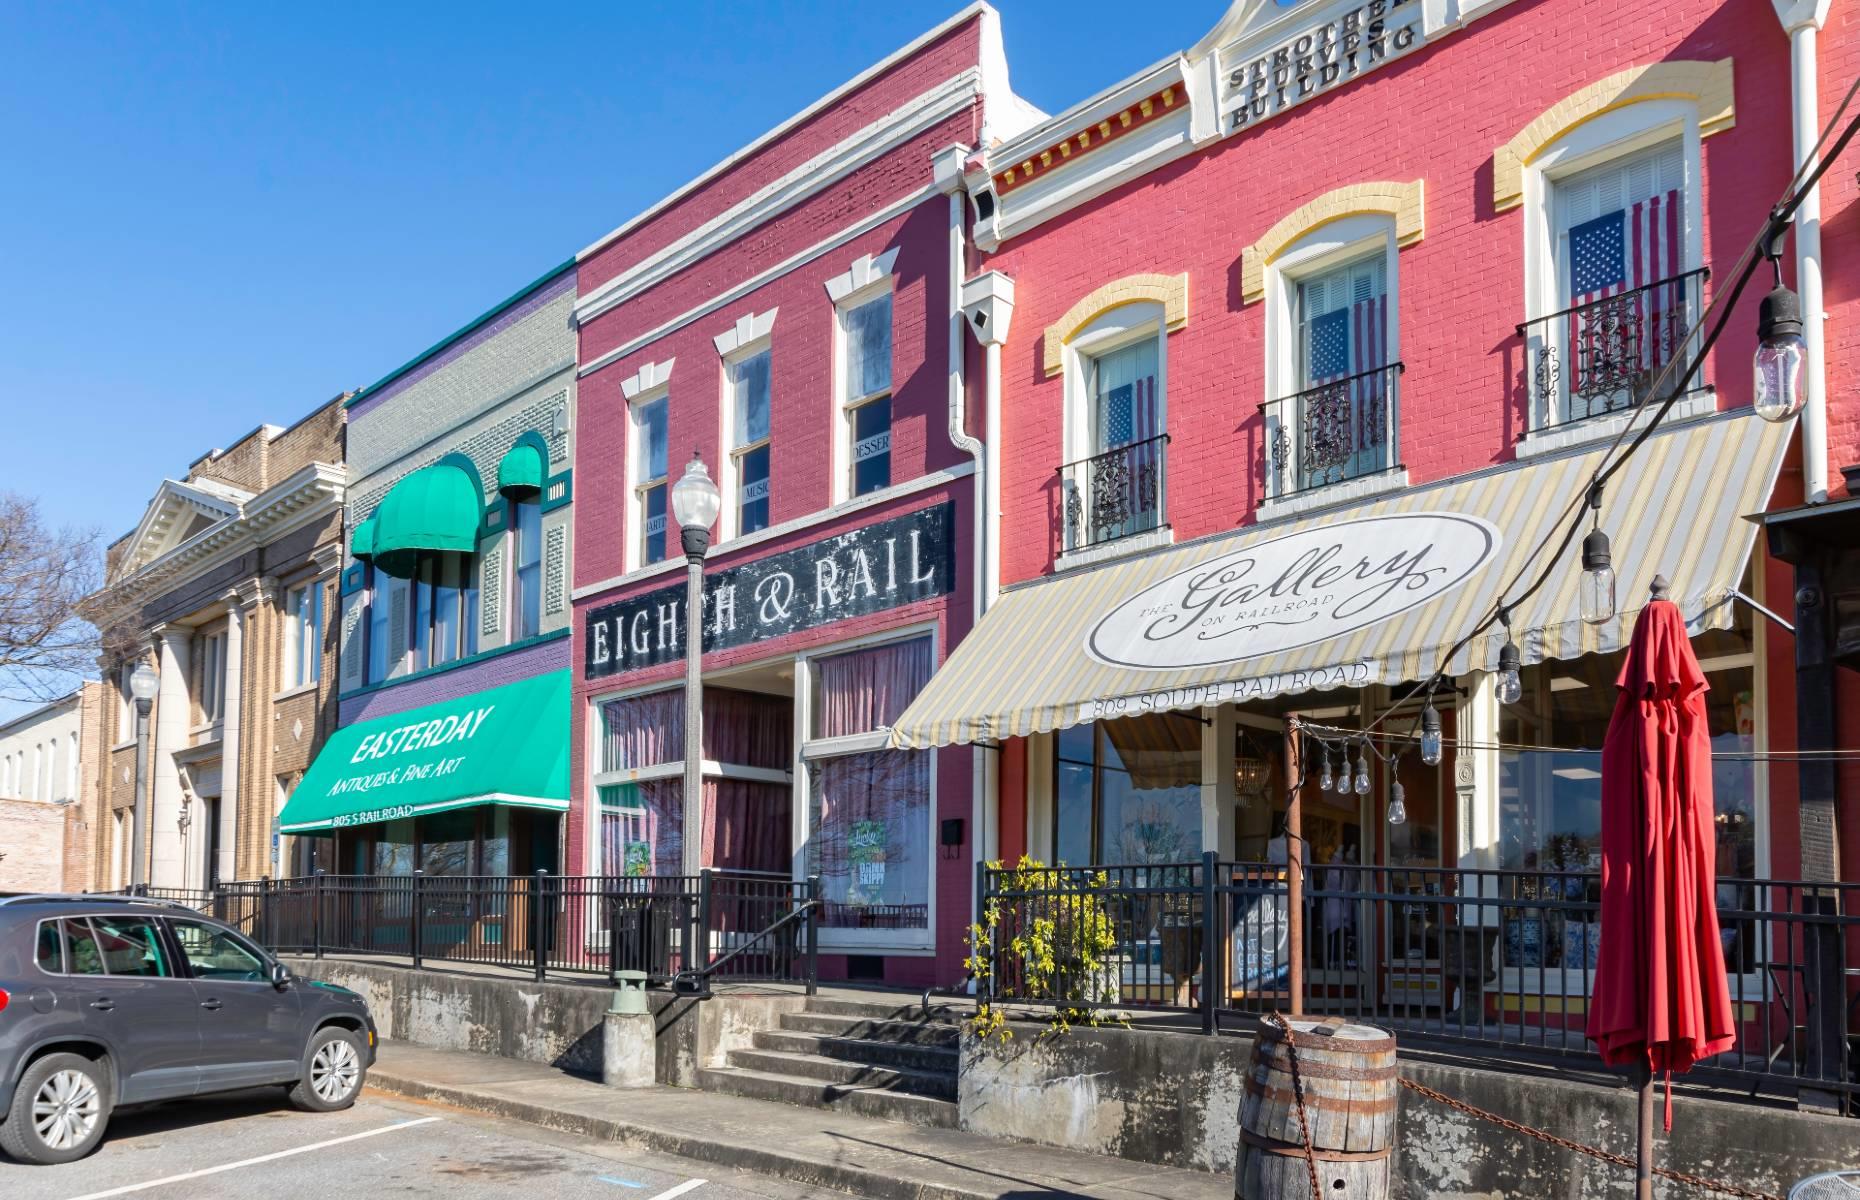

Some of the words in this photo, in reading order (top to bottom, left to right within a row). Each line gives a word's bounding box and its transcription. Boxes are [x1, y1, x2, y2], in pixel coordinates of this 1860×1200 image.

[1232, 24, 1415, 128] BUILDING
[1251, 19, 1385, 99] PURVES
[592, 583, 736, 664] EIGHH
[754, 572, 794, 624] &
[814, 528, 935, 609] RAIL
[1138, 603, 1174, 618] THE
[1143, 543, 1446, 641] Gallery
[1201, 615, 1226, 628] ON
[1234, 594, 1335, 622] RAILROAD
[1093, 697, 1127, 716] 809
[1139, 682, 1220, 710] SOUTH
[1232, 662, 1369, 697] RAILROAD
[350, 705, 496, 764] EASTERDAY
[326, 771, 391, 796] ANTIQUES
[386, 767, 400, 785] &
[398, 764, 434, 784] FINE
[430, 756, 466, 778] ART
[332, 814, 351, 827] 805
[352, 812, 359, 825] S
[360, 804, 414, 823] RAILROAD
